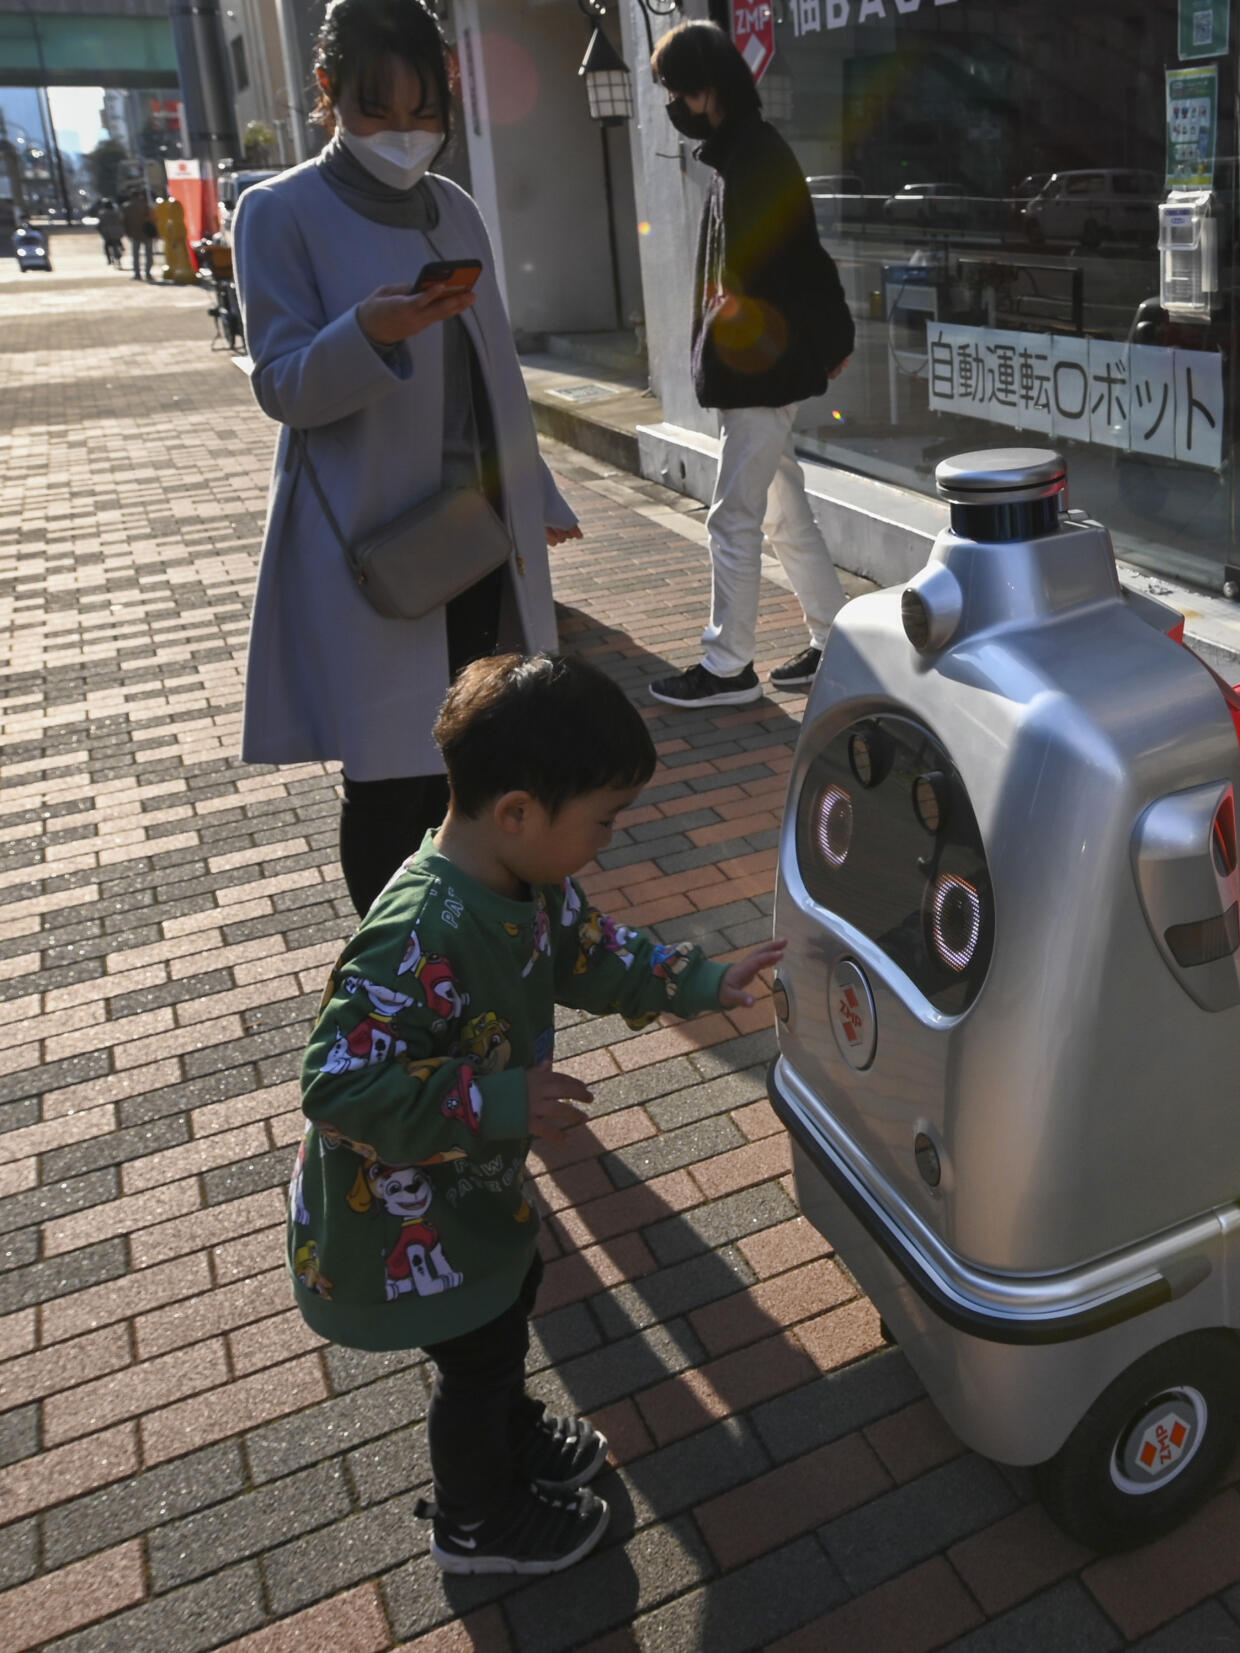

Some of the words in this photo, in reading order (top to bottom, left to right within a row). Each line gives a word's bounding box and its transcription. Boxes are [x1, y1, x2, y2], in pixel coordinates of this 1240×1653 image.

[734, 5, 769, 35] ZMP
[930, 331, 1216, 450] 自動運転ロボット
[840, 1000, 862, 1027] ZMP
[1155, 1424, 1173, 1465] ZMP
